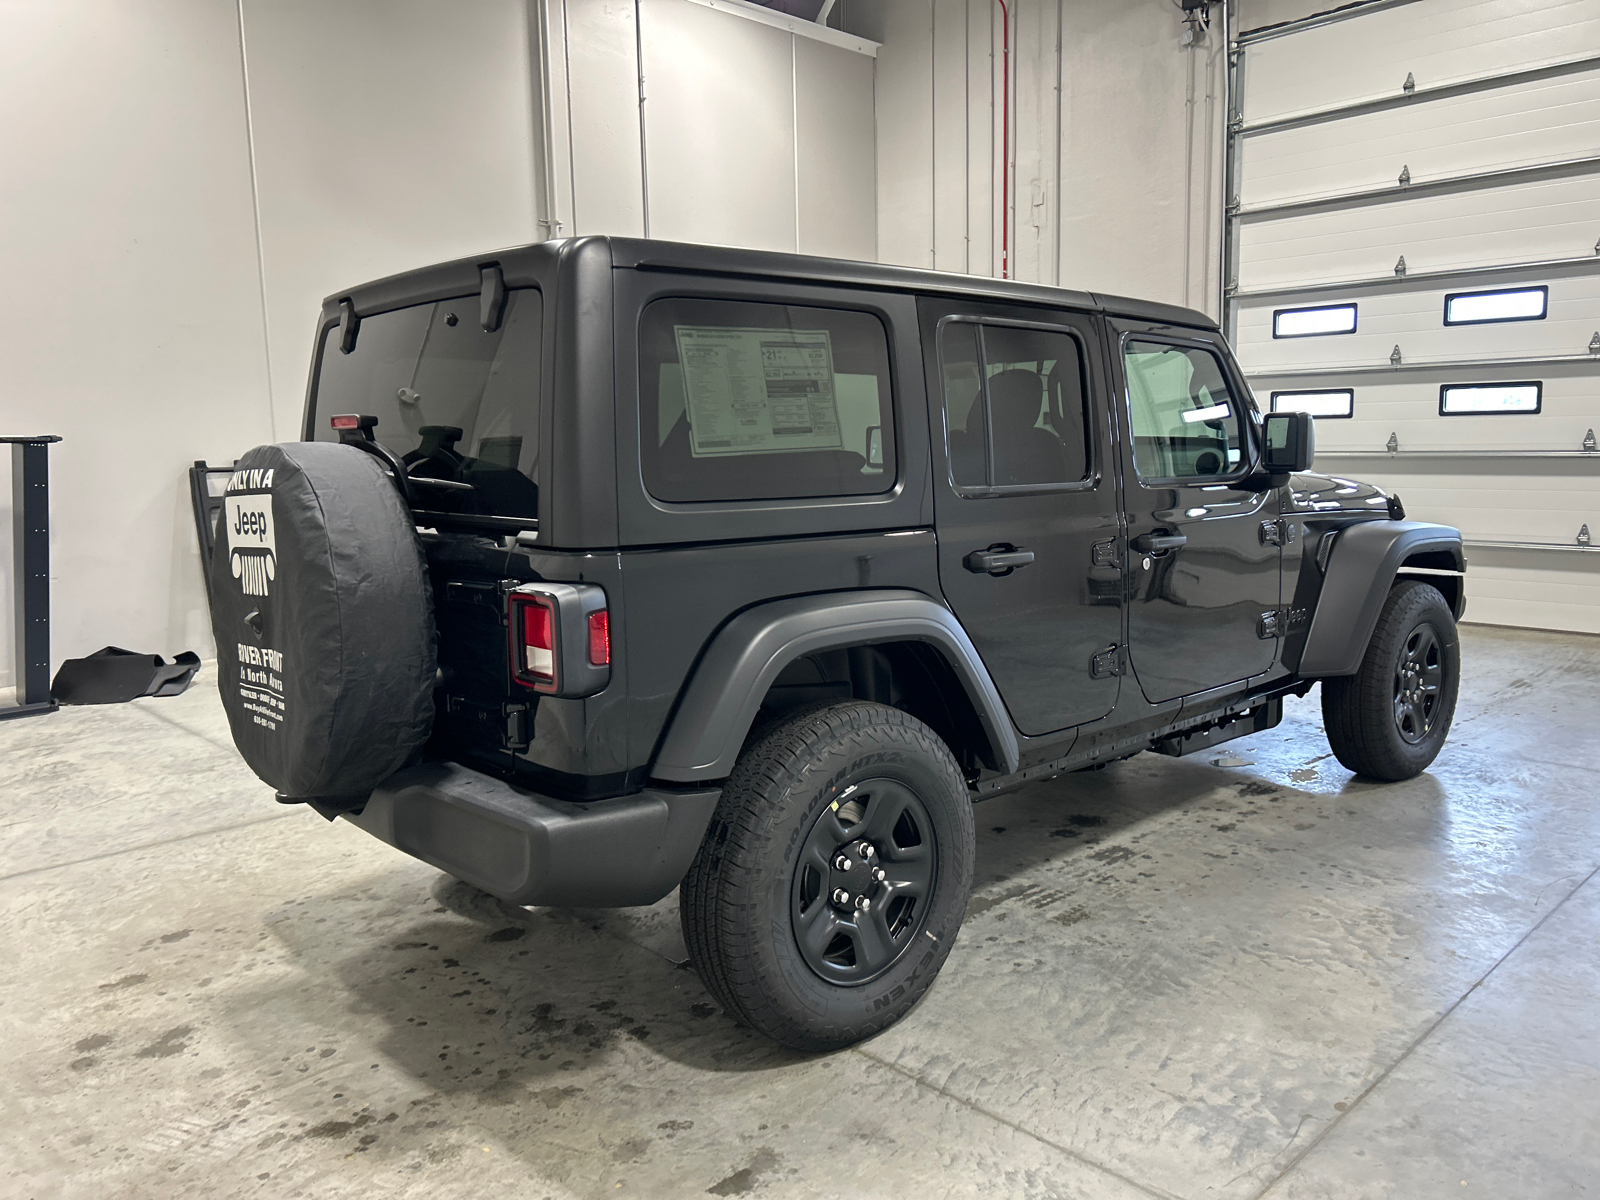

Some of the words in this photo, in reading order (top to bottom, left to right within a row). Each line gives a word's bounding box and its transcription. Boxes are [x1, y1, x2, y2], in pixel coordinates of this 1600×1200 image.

[766, 350, 777, 360] 21
[250, 468, 264, 489] IN
[262, 468, 274, 488] A
[234, 504, 267, 543] Jeep
[237, 643, 262, 666] RIVER
[247, 668, 268, 685] North
[783, 766, 847, 863] ROADIAN
